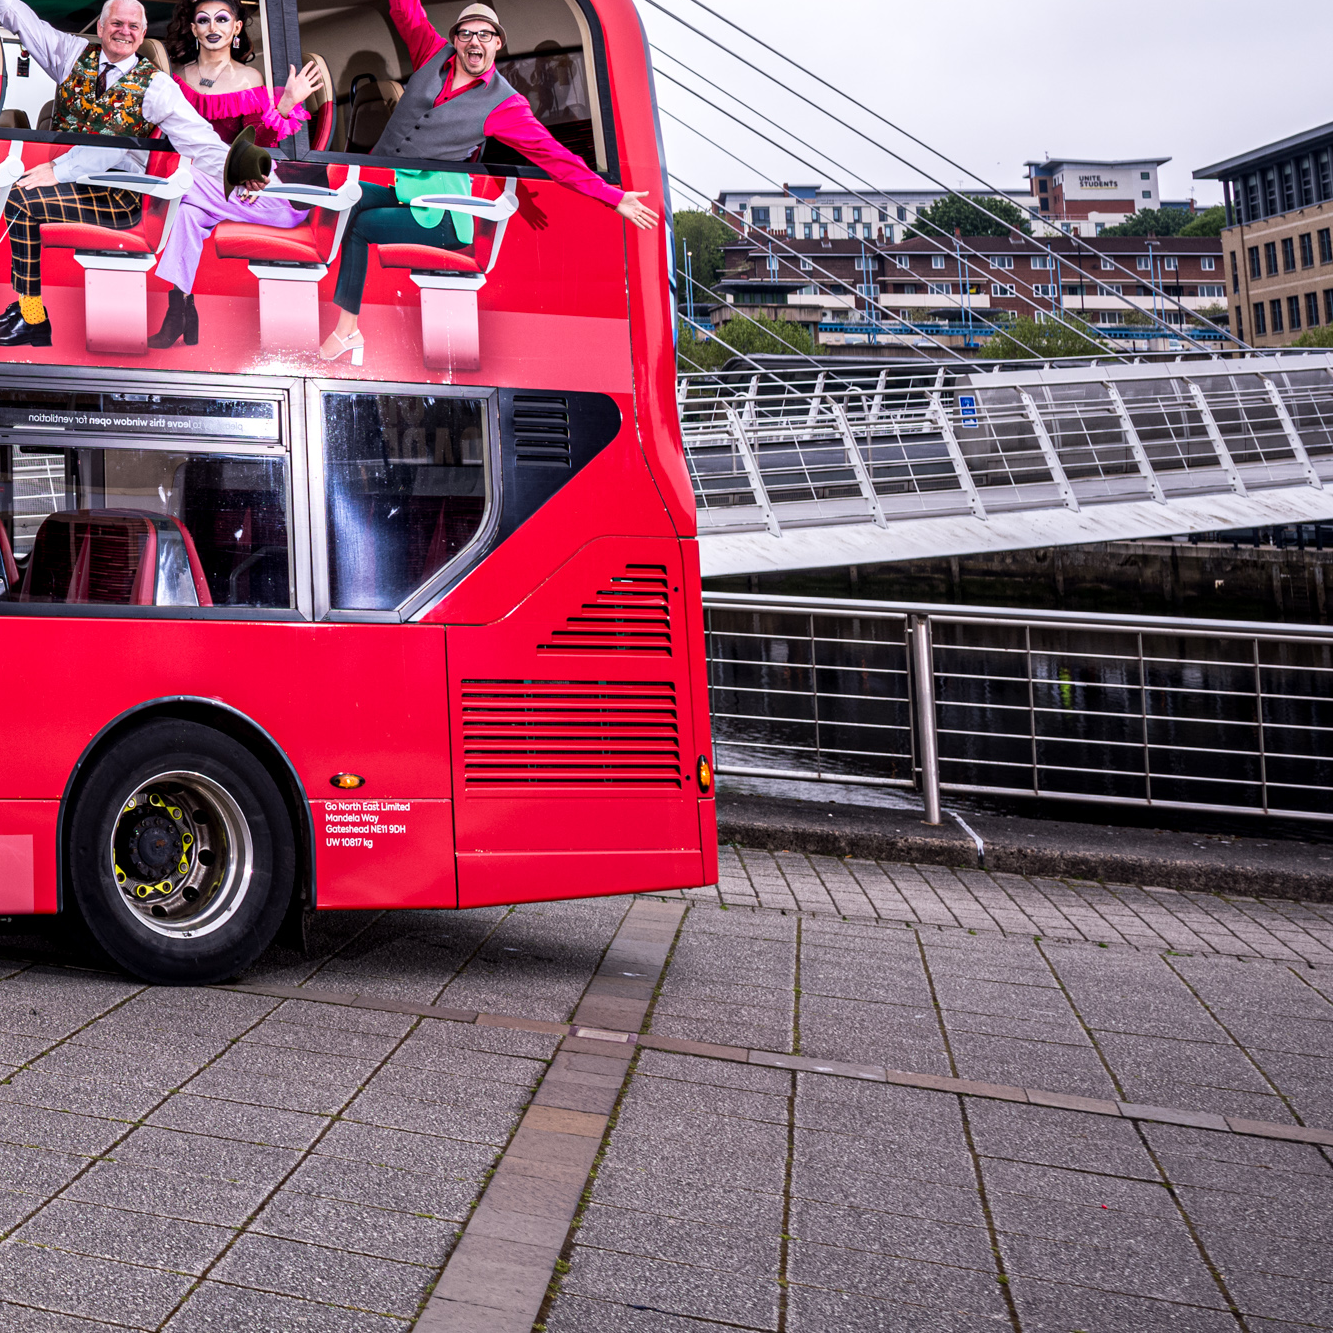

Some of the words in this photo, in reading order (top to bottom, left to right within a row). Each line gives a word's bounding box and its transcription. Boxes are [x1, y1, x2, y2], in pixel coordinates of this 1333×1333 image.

[325, 802, 337, 811] Go
[338, 802, 361, 811] North
[362, 802, 380, 811] East
[381, 802, 410, 811] Limited
[325, 813, 360, 822] Mandela
[361, 814, 379, 824] Way
[325, 824, 369, 833] Gateshead
[370, 825, 388, 833] NE11
[389, 825, 406, 833] 9DH
[326, 838, 340, 847] UW
[341, 838, 362, 847] 10817
[363, 838, 373, 849] kg
